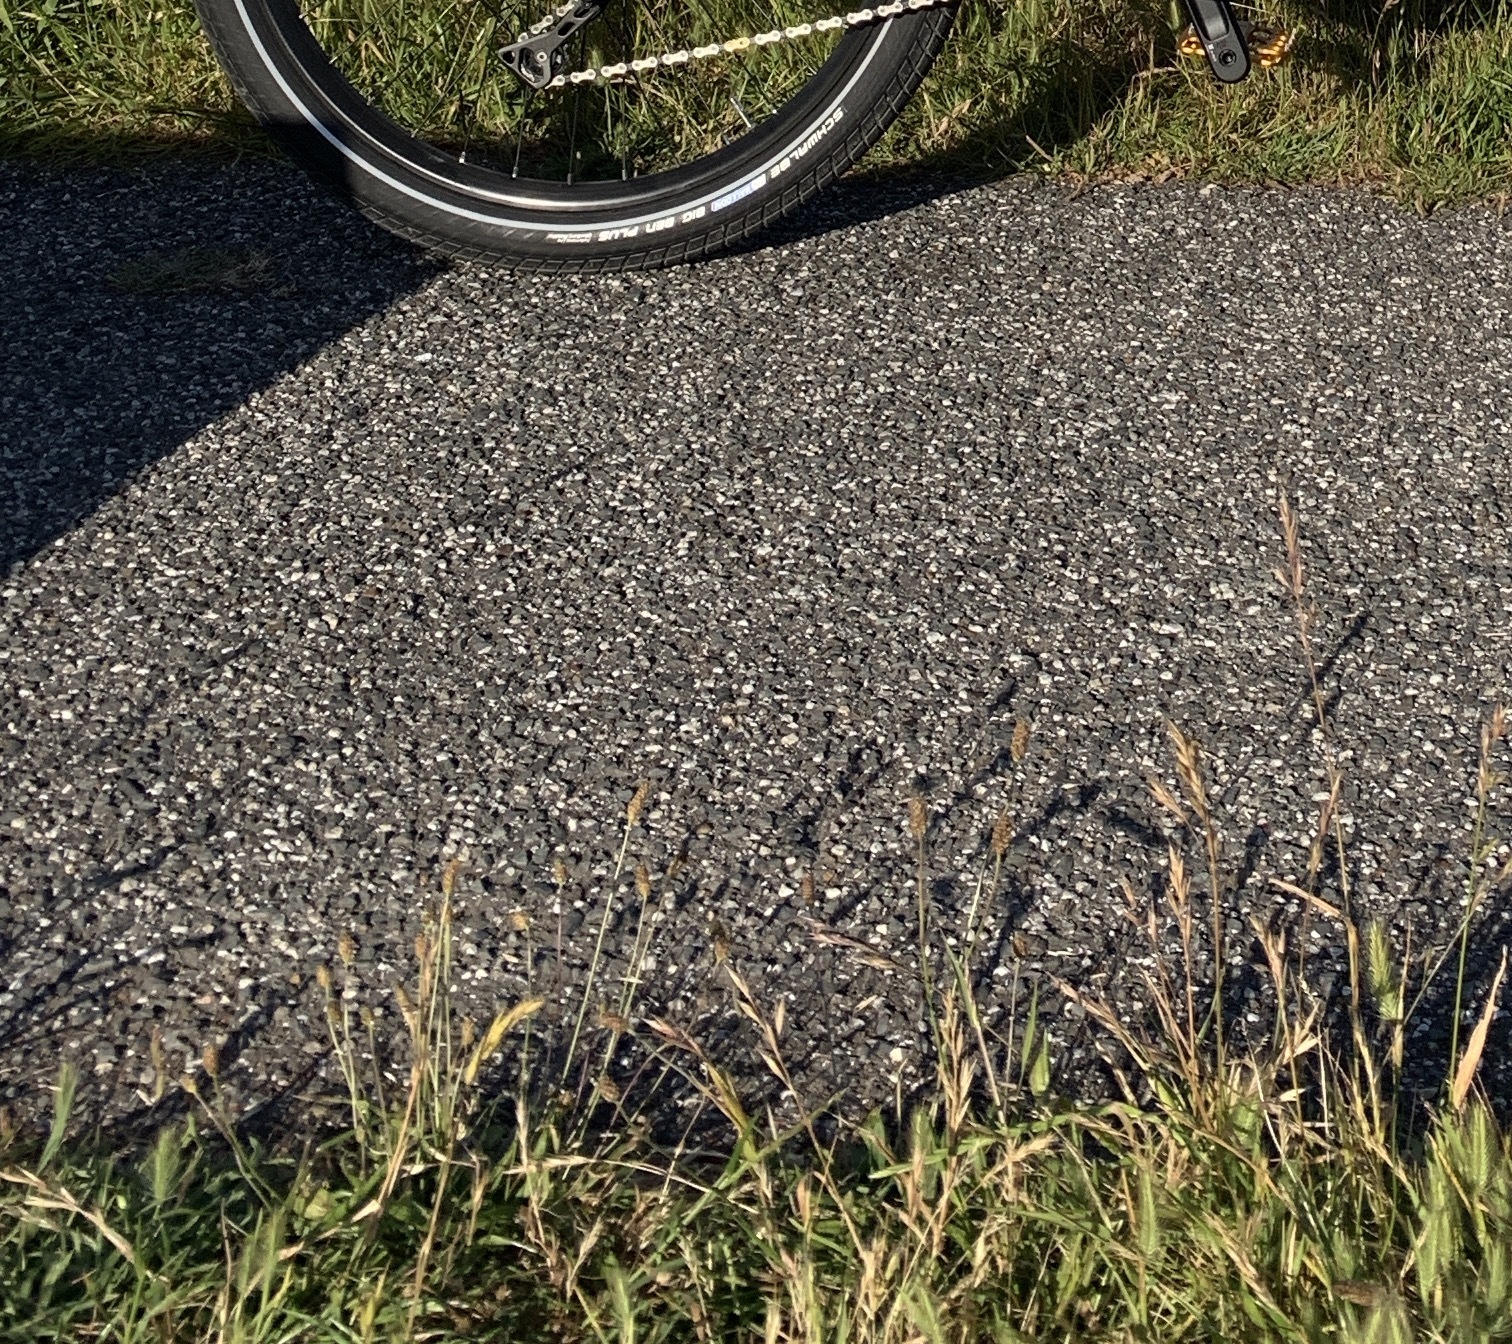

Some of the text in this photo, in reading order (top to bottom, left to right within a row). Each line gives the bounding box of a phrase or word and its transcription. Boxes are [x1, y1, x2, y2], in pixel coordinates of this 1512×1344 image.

[770, 107, 844, 179] SCHWALBE
[682, 206, 706, 224] BIG
[597, 226, 639, 242] PLUS
